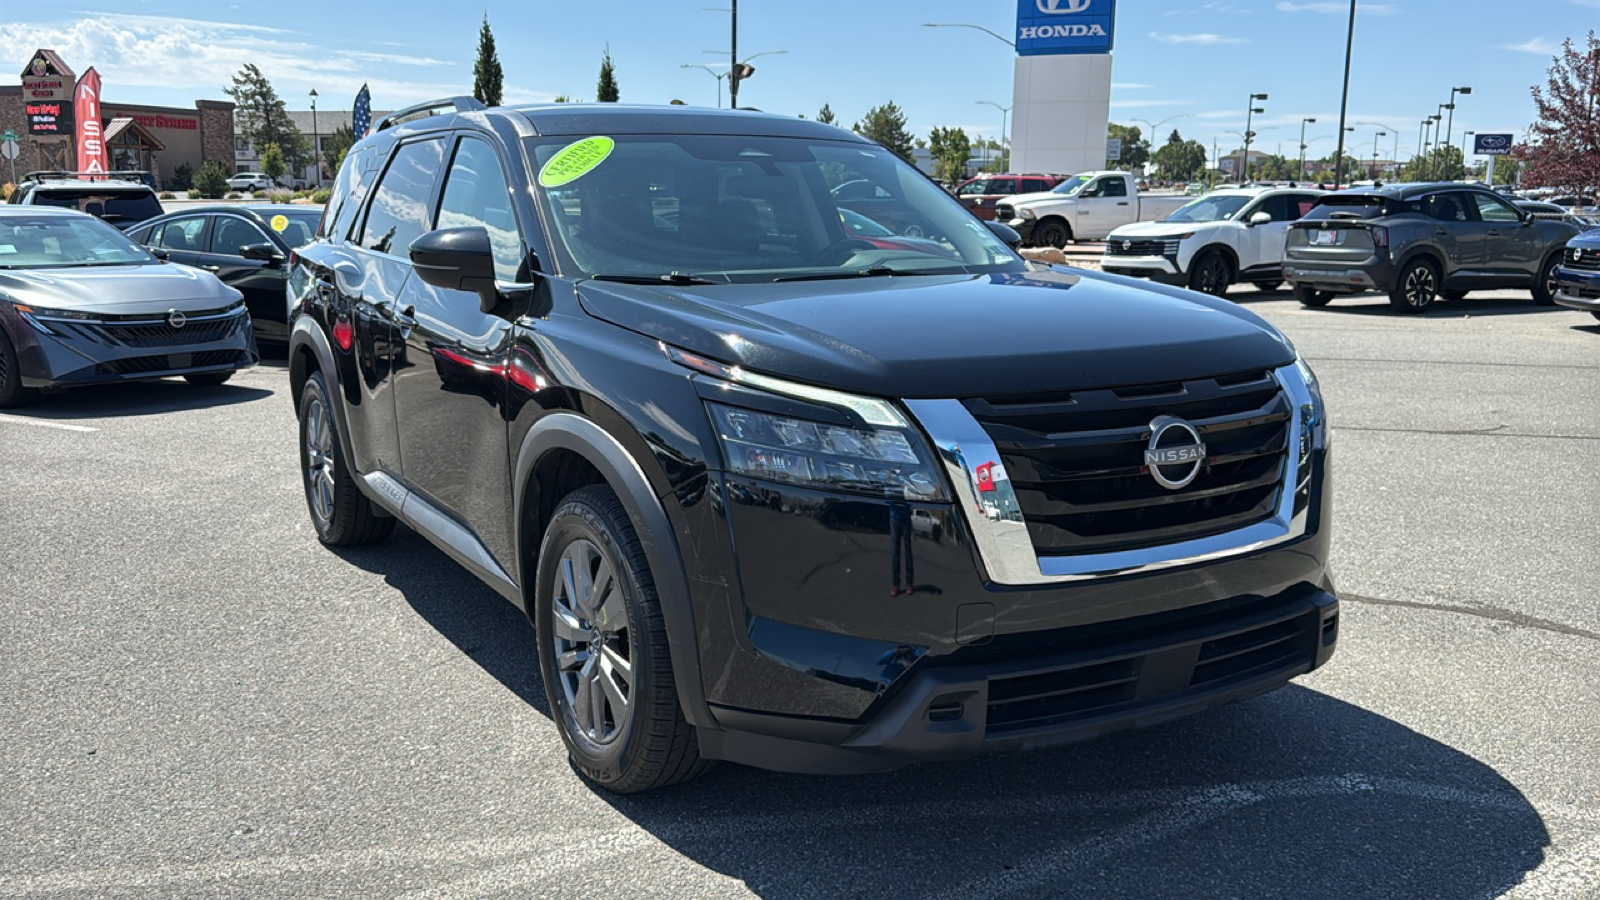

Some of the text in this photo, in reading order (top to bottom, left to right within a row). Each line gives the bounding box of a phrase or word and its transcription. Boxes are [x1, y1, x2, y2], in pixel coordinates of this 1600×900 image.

[1020, 24, 1106, 39] HONDA
[81, 84, 103, 174] NISSA
[545, 140, 594, 176] CERTIFIED
[570, 151, 604, 173] VEHICLE
[1147, 447, 1206, 461] NISSAN
